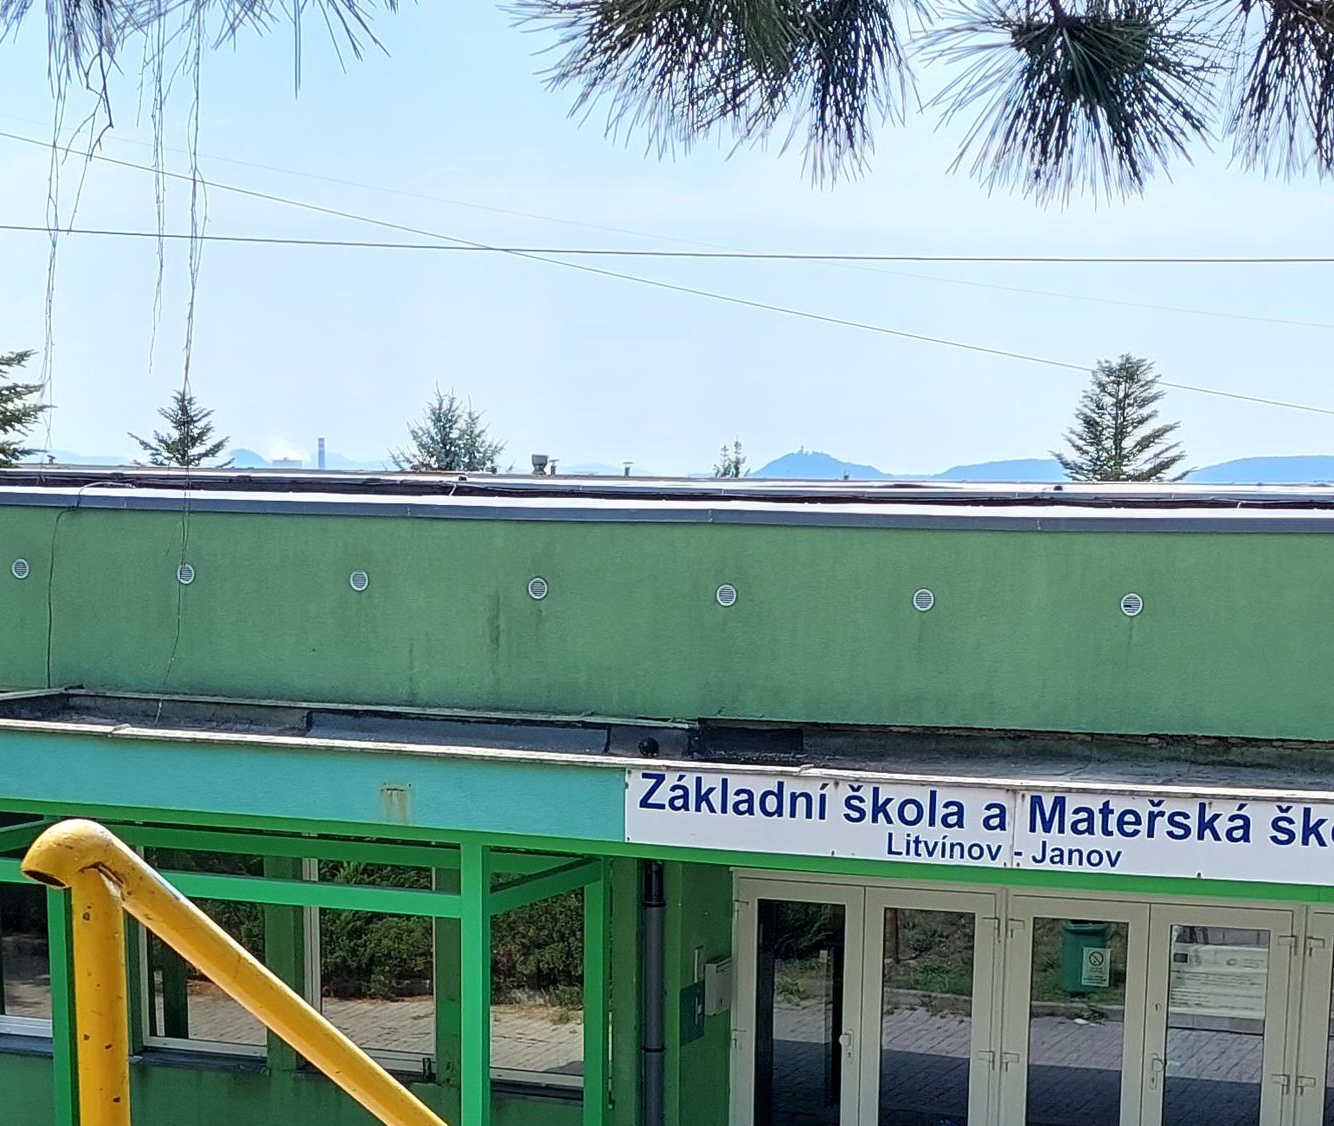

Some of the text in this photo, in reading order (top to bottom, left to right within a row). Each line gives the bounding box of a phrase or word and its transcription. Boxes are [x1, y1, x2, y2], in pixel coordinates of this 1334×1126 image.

[639, 772, 828, 820] Základní
[842, 785, 966, 829] škola
[982, 802, 1008, 832] a
[1028, 794, 1252, 844] Mateřská
[886, 831, 1003, 862] Litvínov
[1031, 840, 1123, 868] Janov
